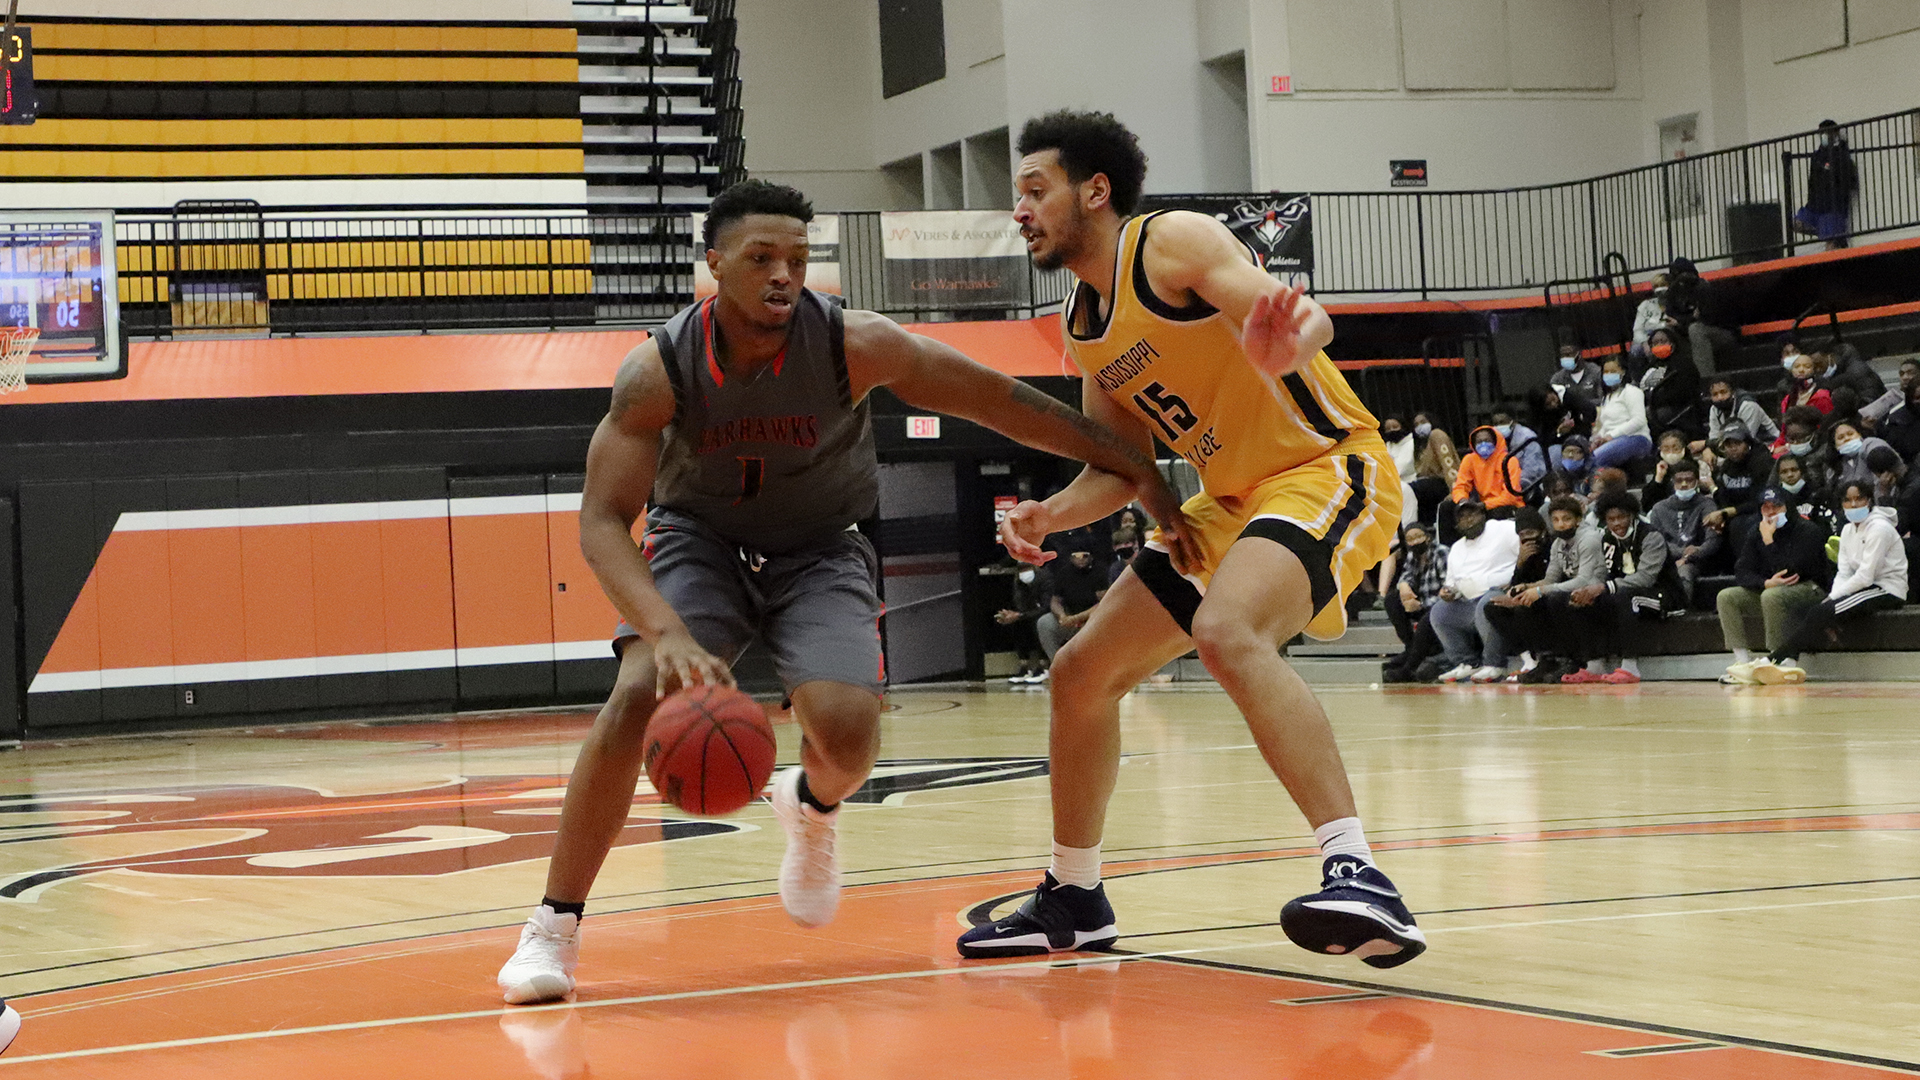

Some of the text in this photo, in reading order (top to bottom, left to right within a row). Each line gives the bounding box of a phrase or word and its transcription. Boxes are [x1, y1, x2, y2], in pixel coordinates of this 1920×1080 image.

[1271, 76, 1291, 92] EXIT
[951, 229, 961, 241] &
[1132, 381, 1199, 442] 15
[914, 418, 936, 436] EXIT
